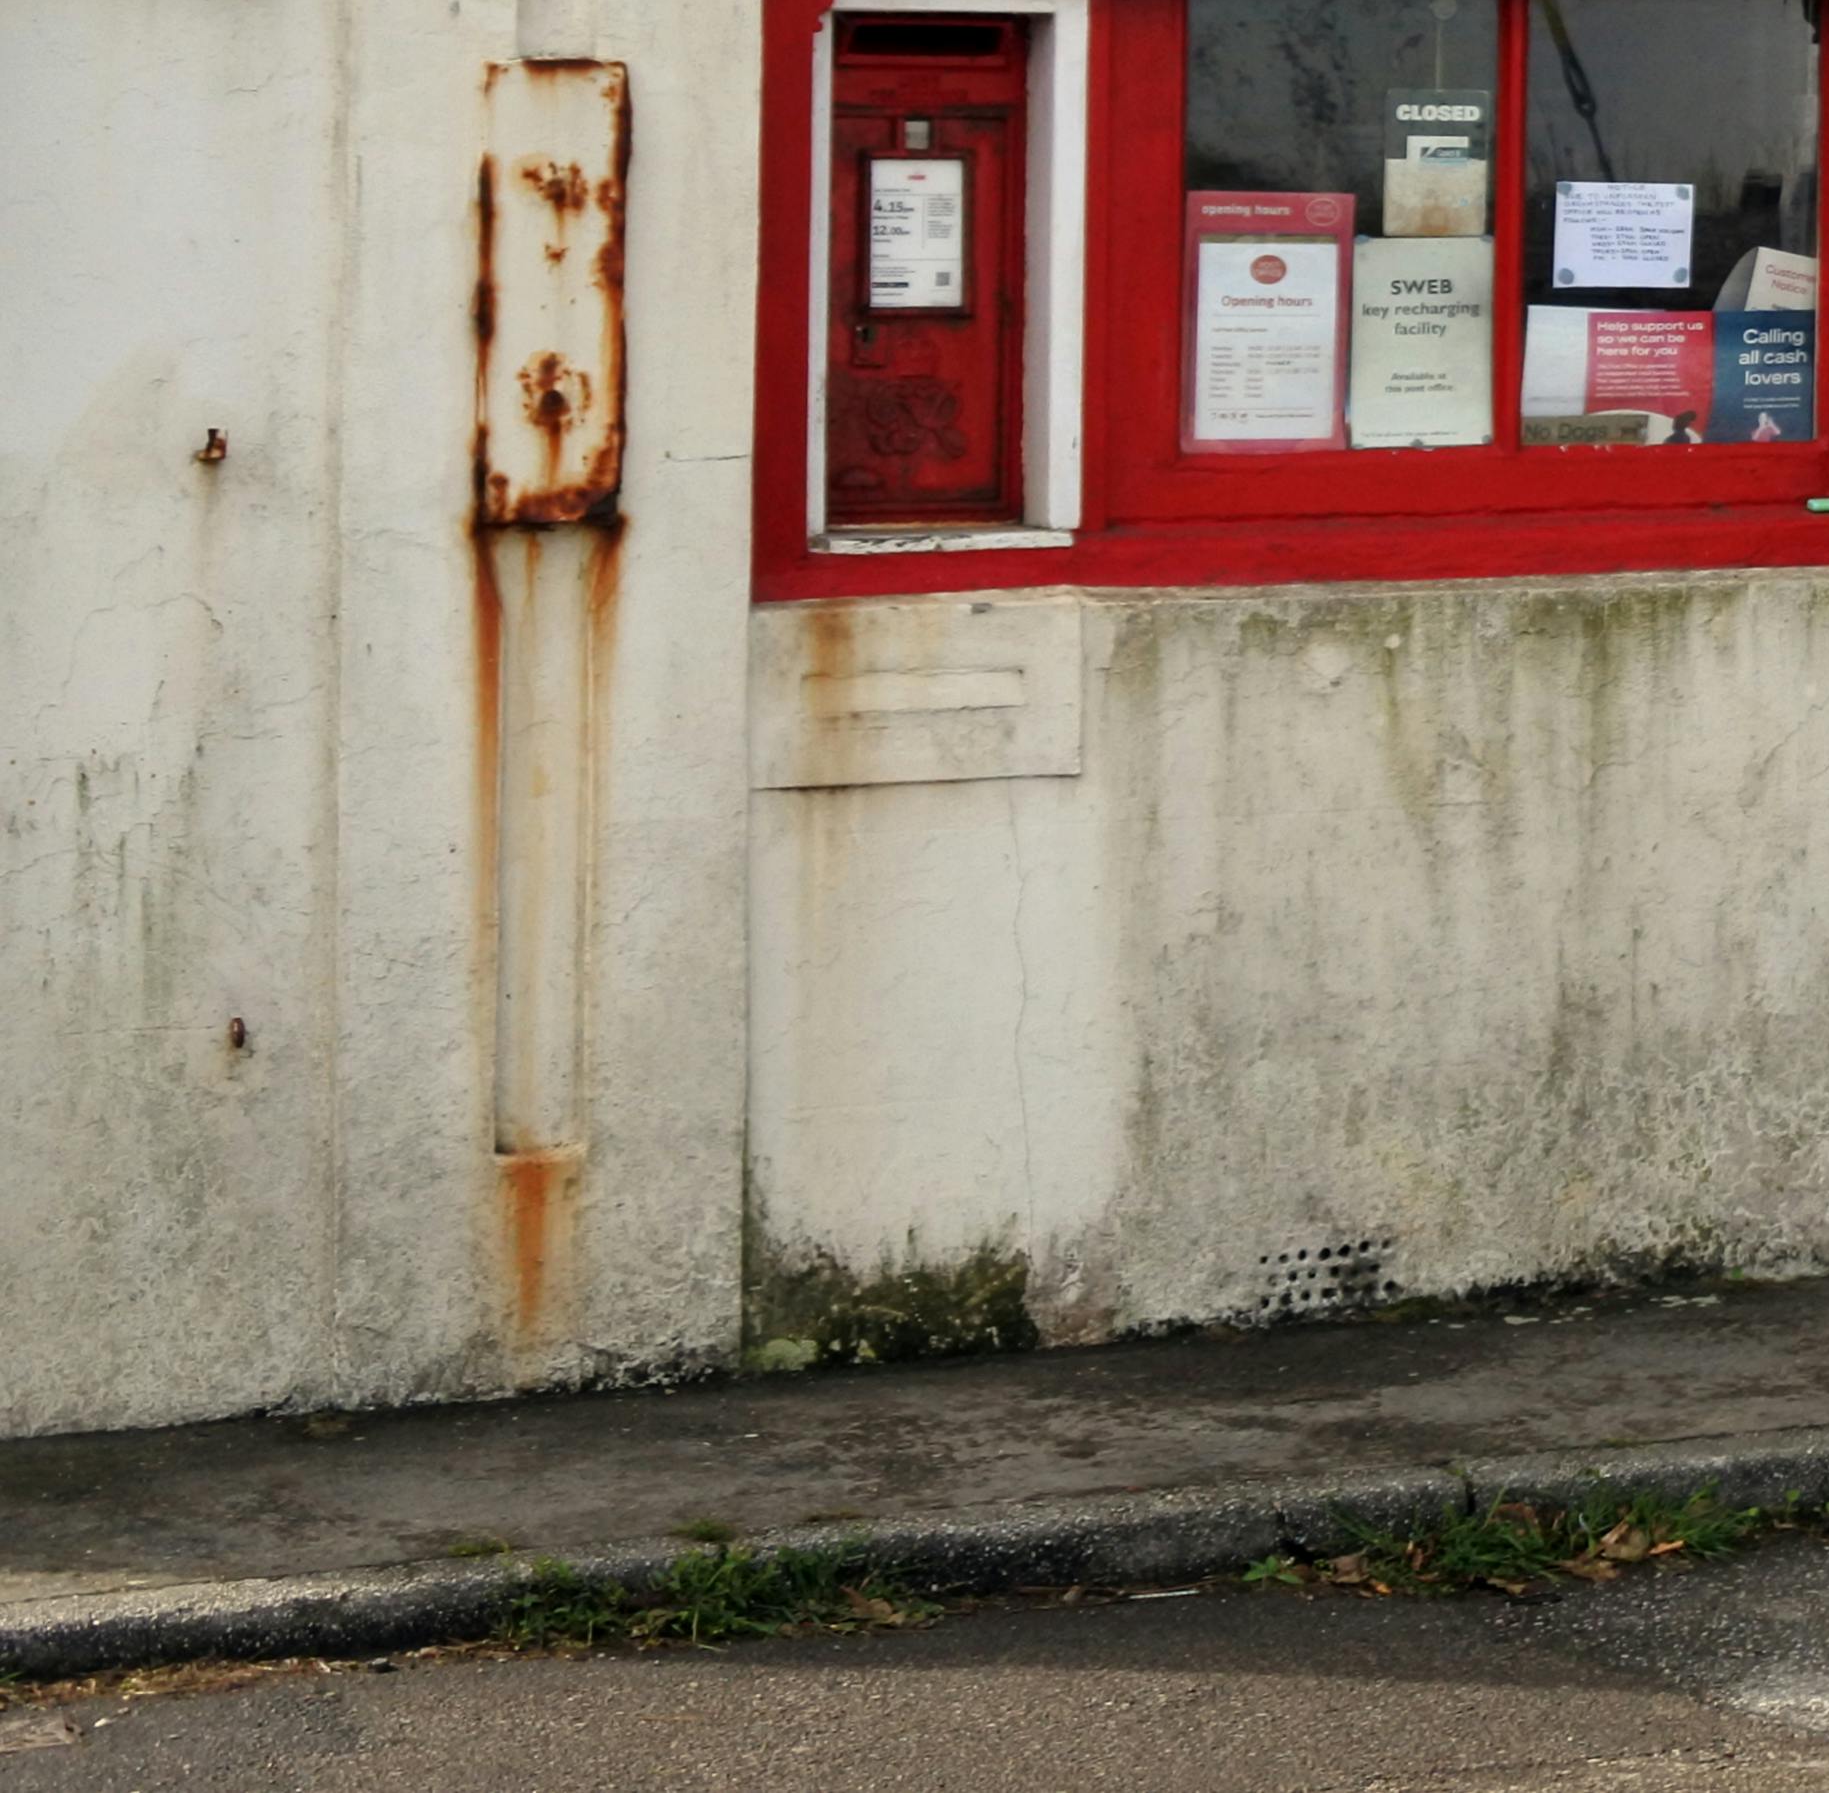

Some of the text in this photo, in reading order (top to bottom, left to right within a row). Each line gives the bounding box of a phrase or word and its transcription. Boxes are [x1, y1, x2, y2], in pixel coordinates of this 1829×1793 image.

[1395, 103, 1481, 122] CLOSED
[1201, 203, 1291, 217] opening hours
[1765, 264, 1816, 282] Custome
[1391, 279, 1453, 295] SWEB
[1770, 280, 1808, 295] Notice
[1221, 295, 1313, 308] Opening hours
[1362, 302, 1481, 319] key recharging
[1394, 322, 1447, 337] facility
[1597, 321, 1704, 333] Help support us
[1596, 333, 1685, 343] so we can be
[1742, 328, 1805, 346] Calling
[1596, 346, 1678, 358] here for you
[1738, 349, 1808, 365] all cash
[1744, 371, 1803, 386] lovers
[1523, 423, 1608, 440] No Dogs
